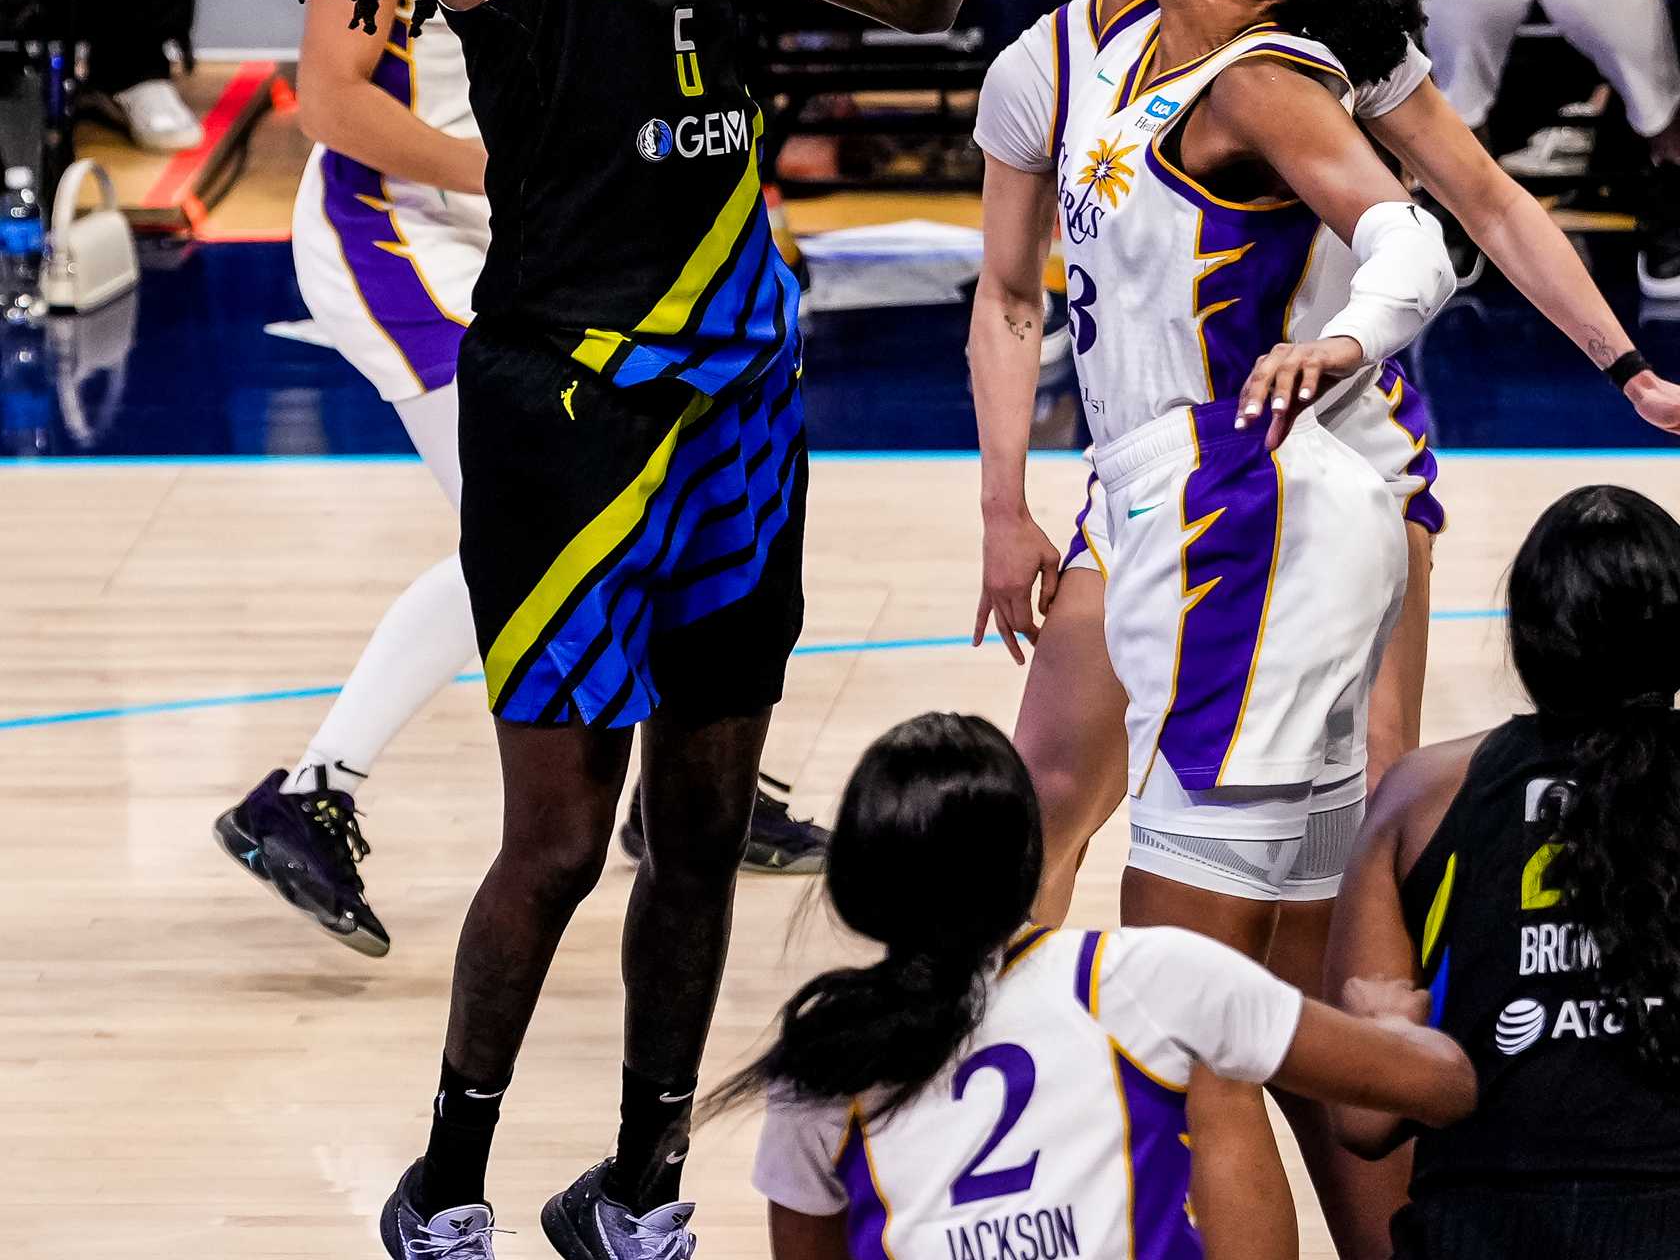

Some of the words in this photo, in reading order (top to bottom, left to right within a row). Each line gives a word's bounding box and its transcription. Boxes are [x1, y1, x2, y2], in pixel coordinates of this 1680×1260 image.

[675, 109, 749, 158] GEM
[1519, 923, 1601, 976] BROW
[950, 1043, 1040, 1206] 2
[946, 1204, 1080, 1260] JACKSON
